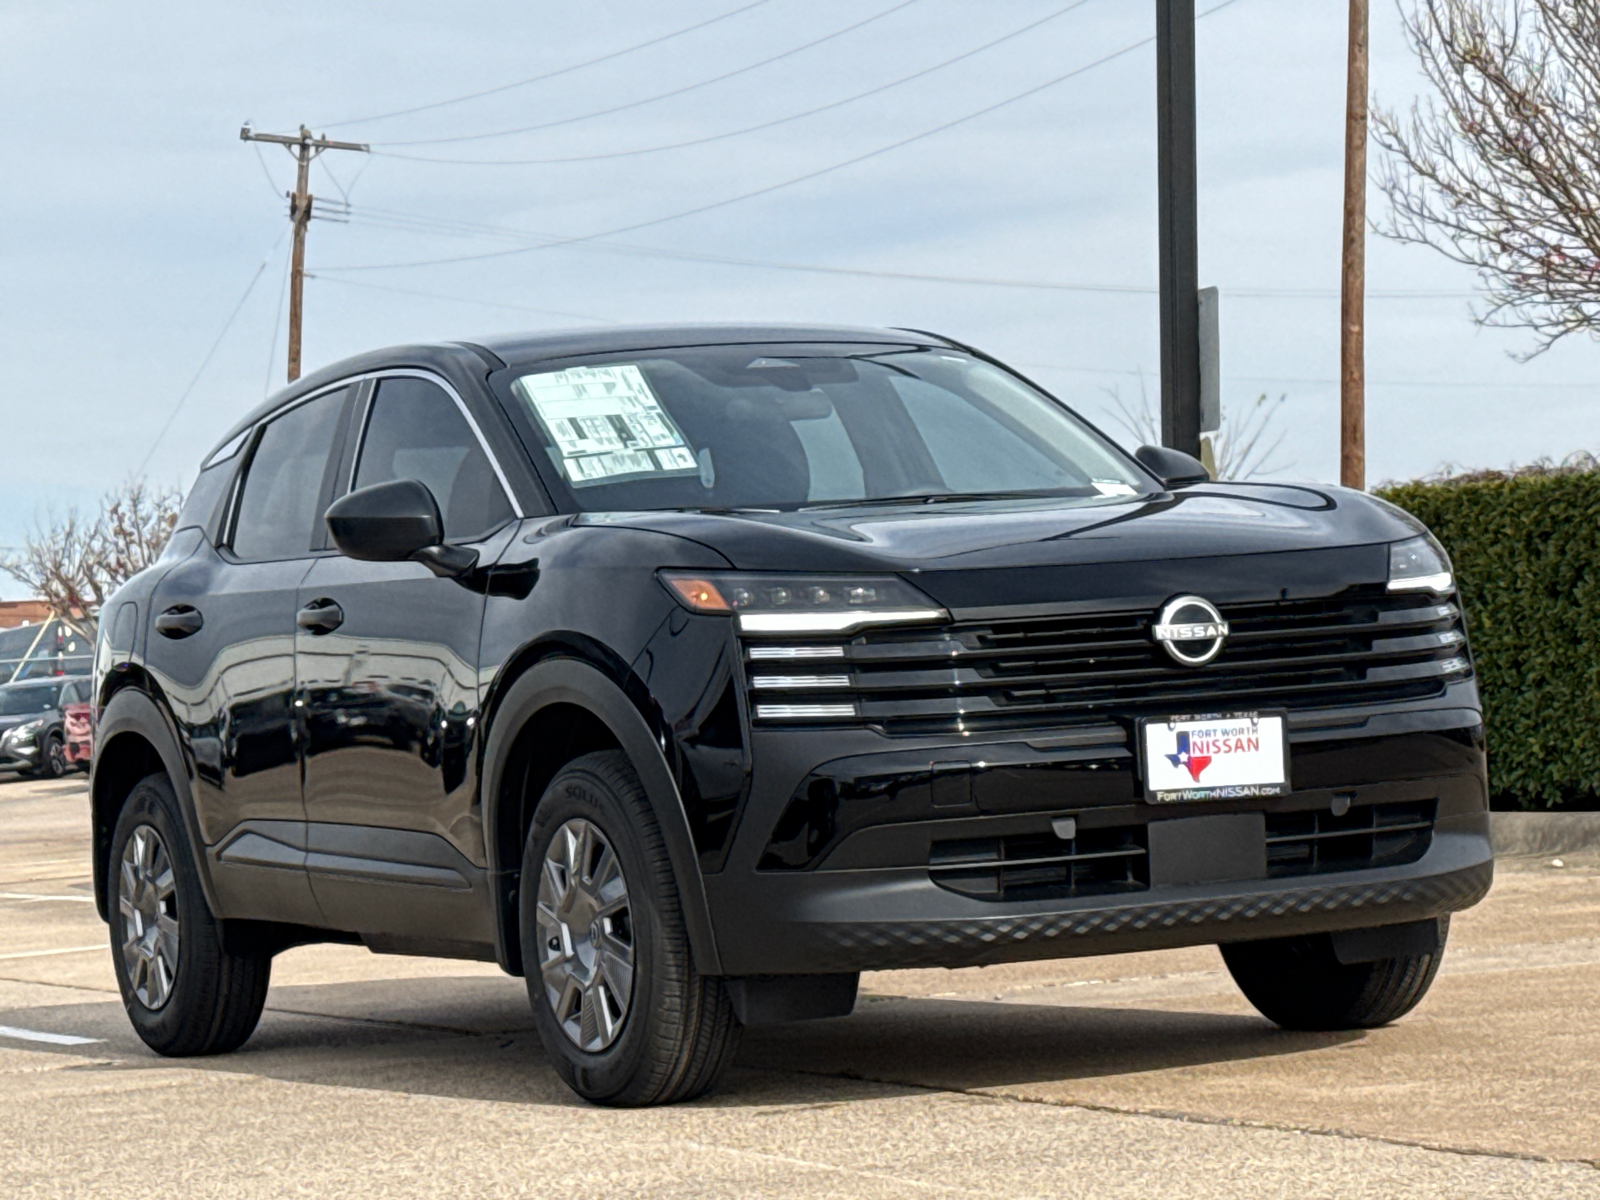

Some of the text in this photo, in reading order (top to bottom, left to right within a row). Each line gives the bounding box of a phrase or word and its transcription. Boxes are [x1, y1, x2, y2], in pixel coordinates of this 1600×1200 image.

[1157, 624, 1229, 639] NISSAN
[1191, 726, 1259, 739] FORT WORTH
[1192, 738, 1259, 754] NISSAN
